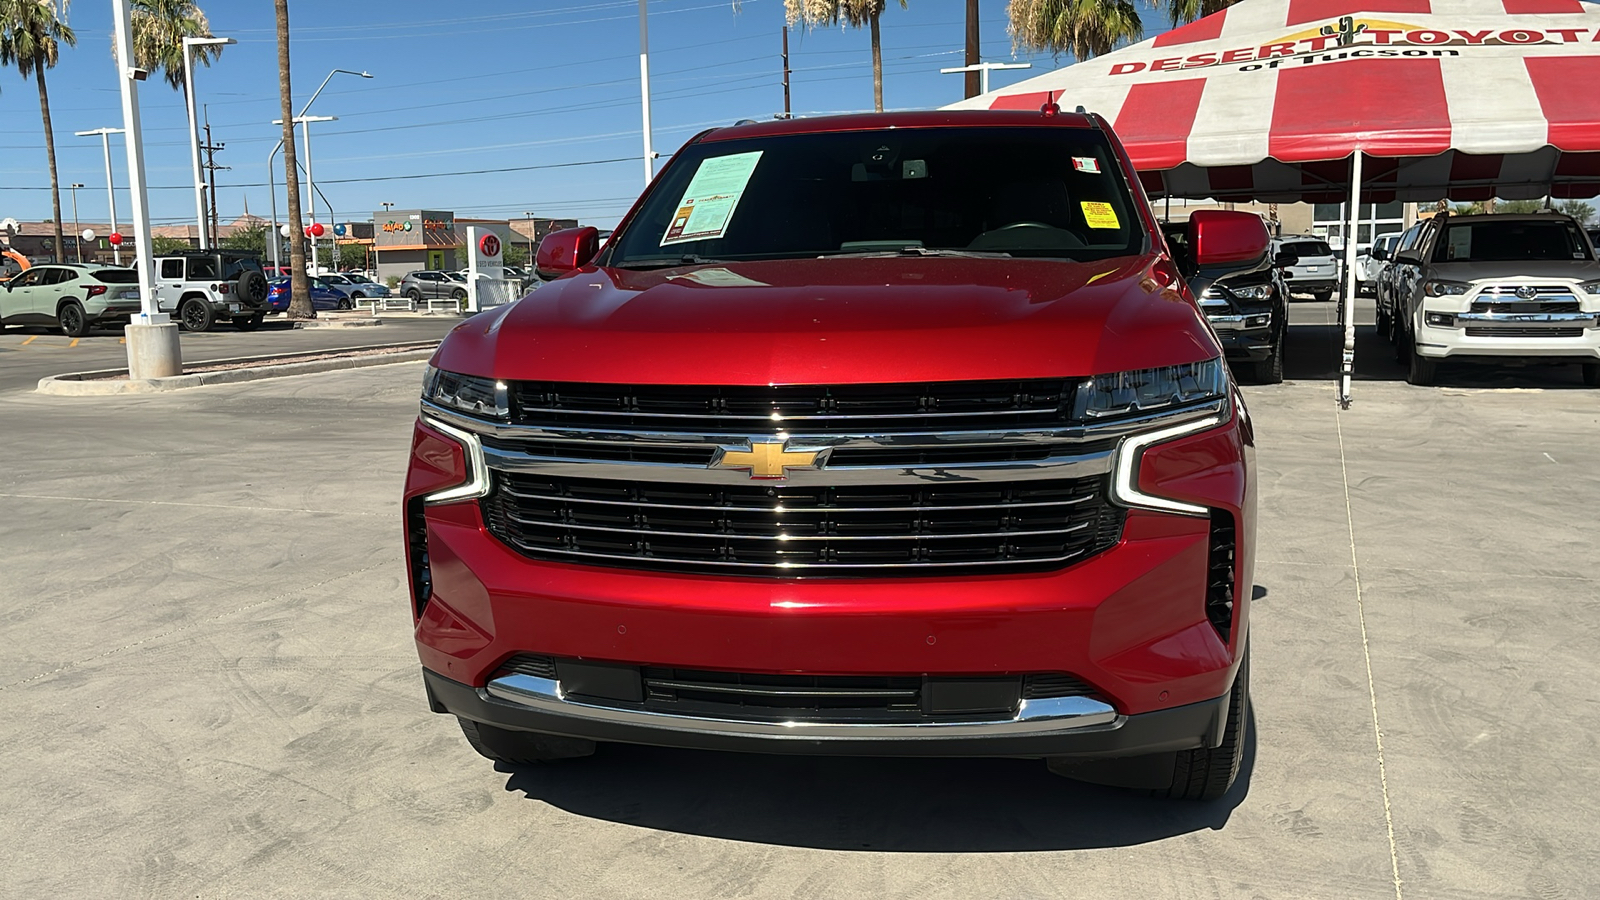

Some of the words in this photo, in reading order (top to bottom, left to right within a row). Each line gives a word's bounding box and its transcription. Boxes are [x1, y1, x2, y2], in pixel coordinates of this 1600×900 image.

[1108, 34, 1338, 76] DESERT
[1362, 29, 1600, 44] TOYOT
[1238, 58, 1285, 72] of
[1292, 49, 1460, 65] Tucson
